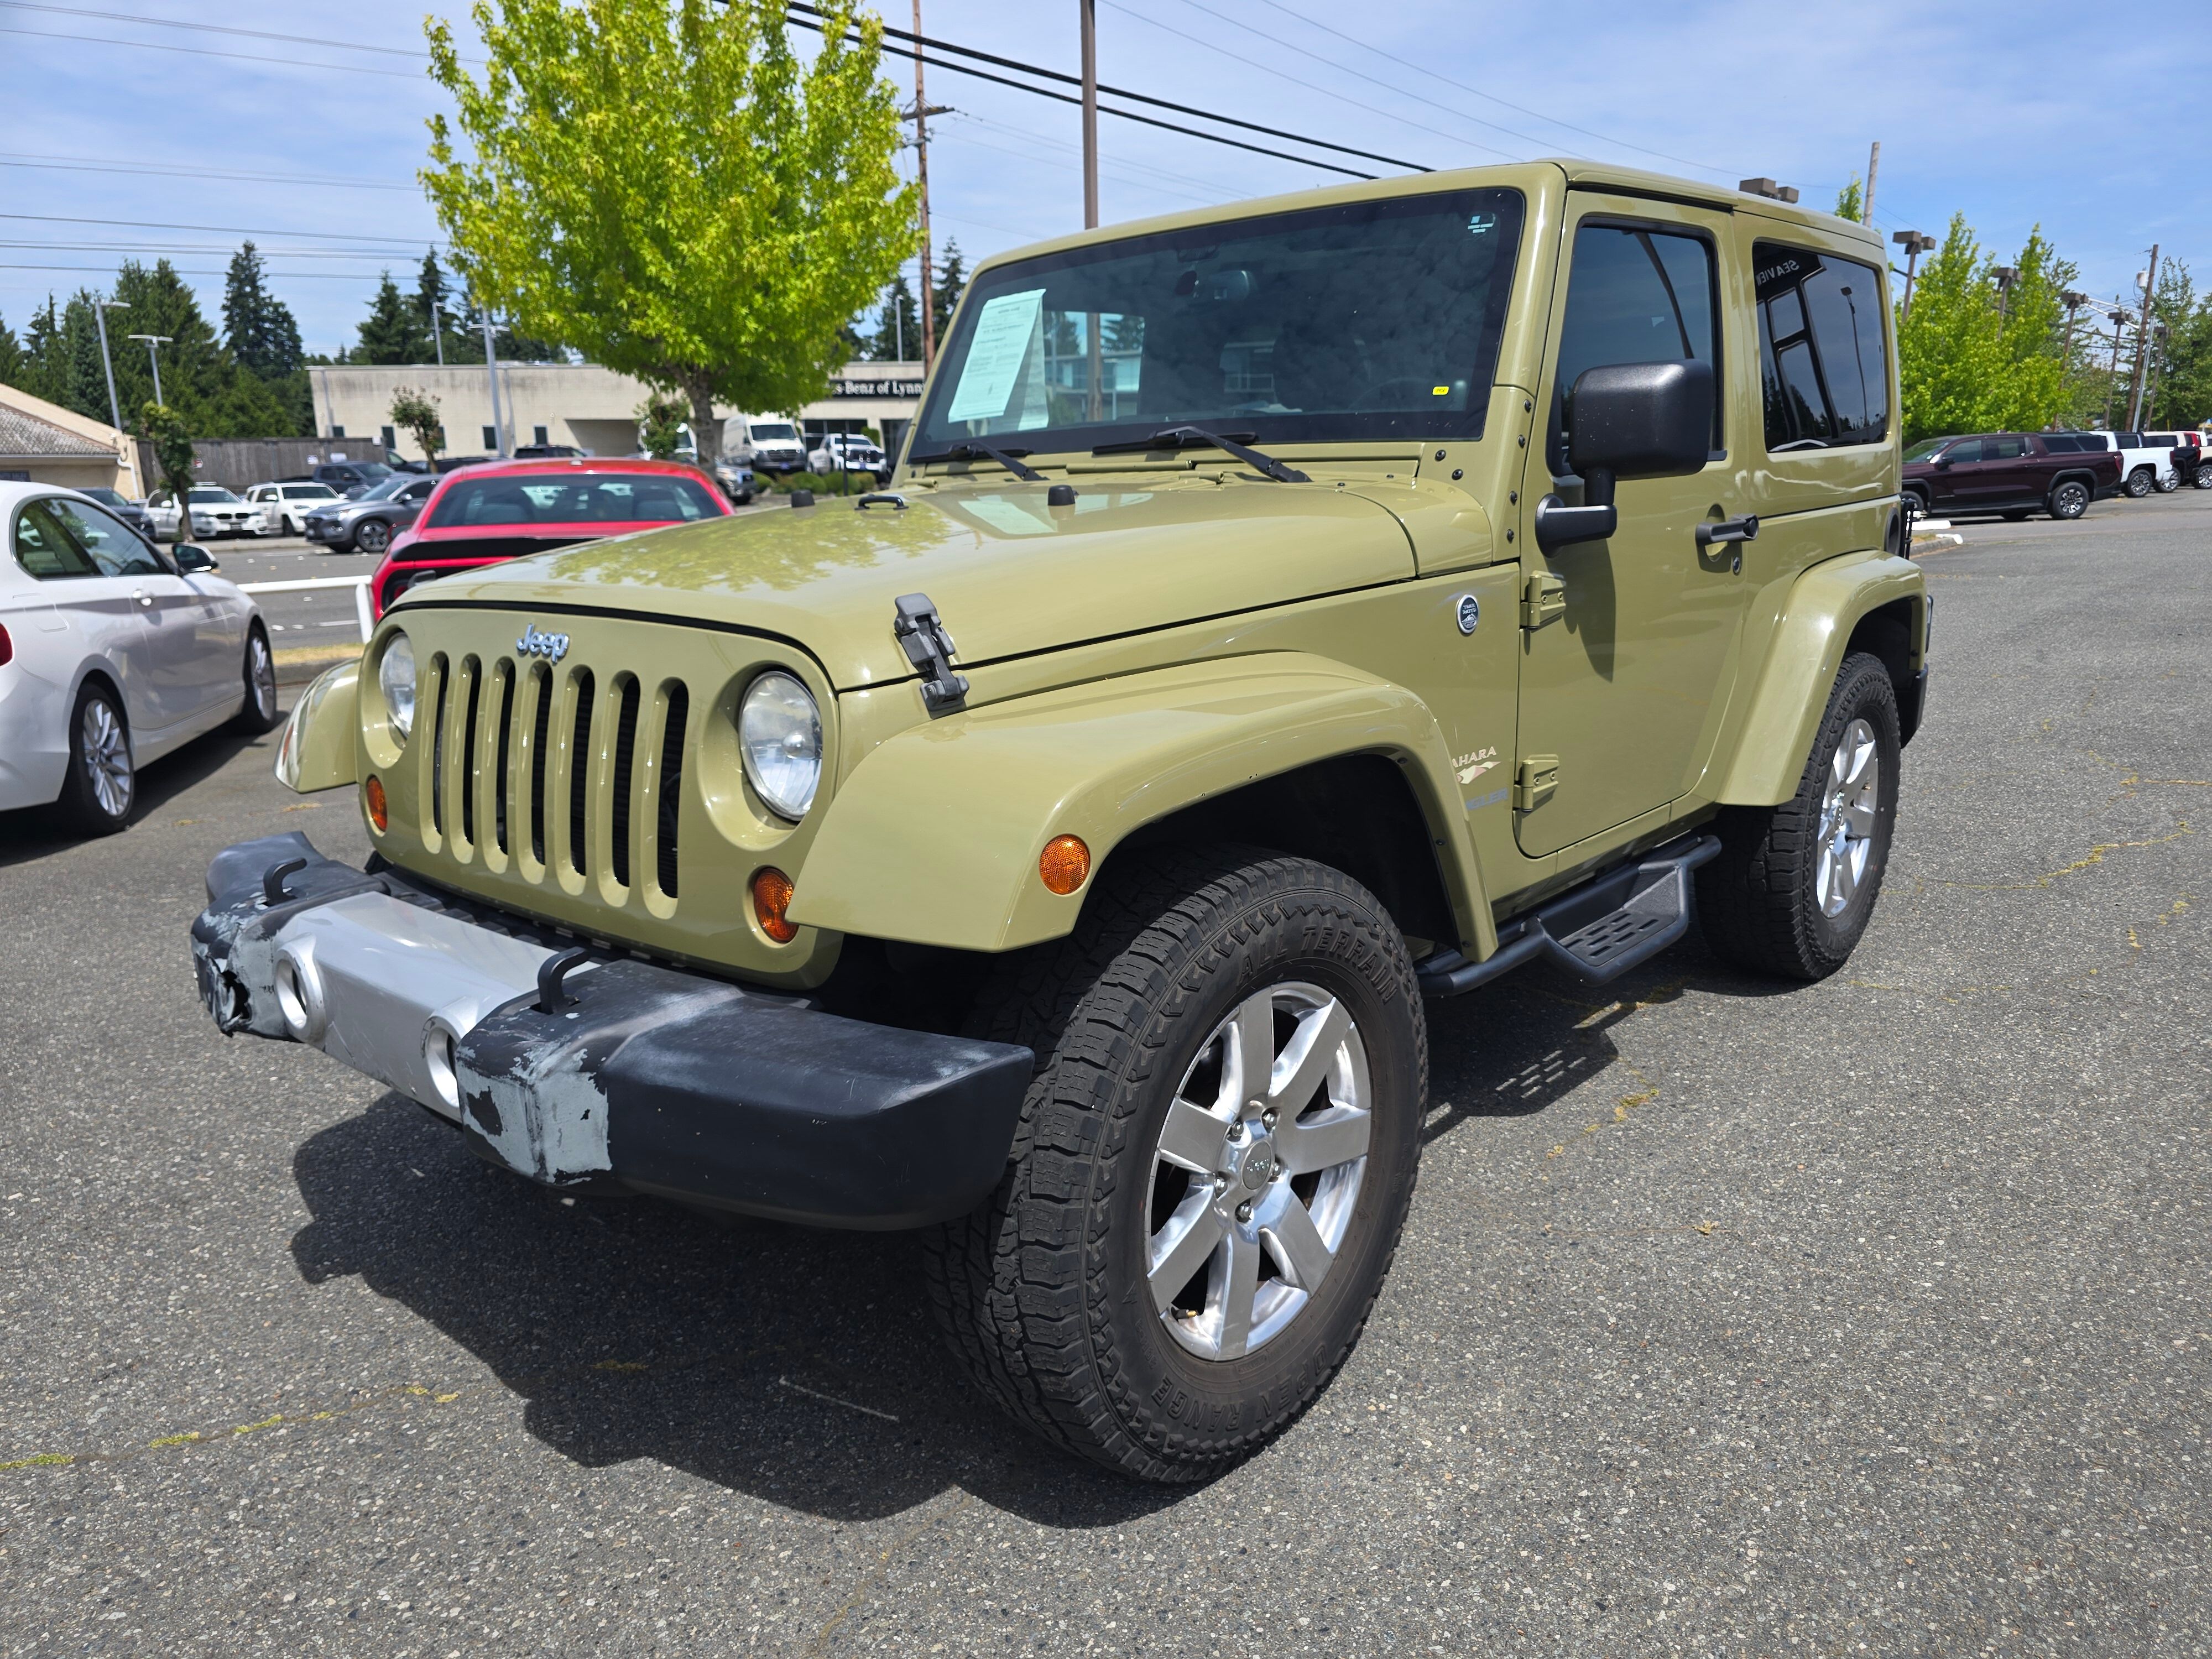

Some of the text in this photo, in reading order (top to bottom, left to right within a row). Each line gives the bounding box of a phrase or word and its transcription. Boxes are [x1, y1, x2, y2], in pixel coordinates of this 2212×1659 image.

[877, 380, 890, 395] of
[892, 380, 924, 398] Lynn
[517, 622, 568, 662] Jeep
[1301, 924, 1398, 1005] TERRAIN
[1151, 1342, 1326, 1432] OPEN RANGE
